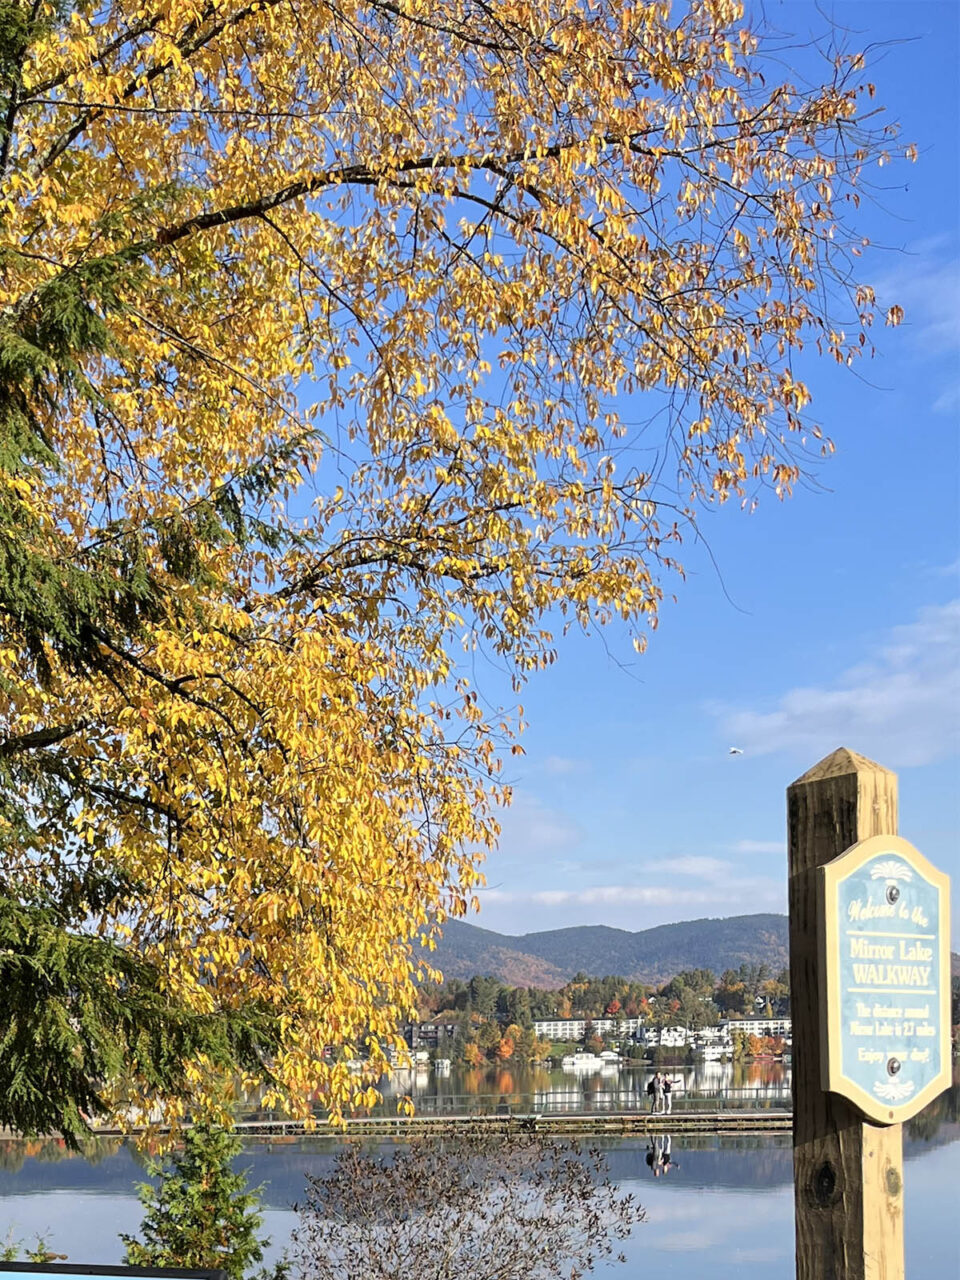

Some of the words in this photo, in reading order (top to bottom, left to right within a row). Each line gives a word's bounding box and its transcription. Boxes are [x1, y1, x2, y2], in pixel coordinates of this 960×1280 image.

[848, 896, 895, 922] Welcome
[899, 901, 910, 919] to
[911, 906, 929, 928] the
[849, 938, 896, 960] Mirror
[899, 940, 933, 962] Lake
[852, 963, 931, 986] WALKWAY
[856, 1002, 871, 1017] The
[850, 1021, 873, 1036] Mirror
[875, 1021, 894, 1036] Lake
[858, 1047, 885, 1065] Enjoy
